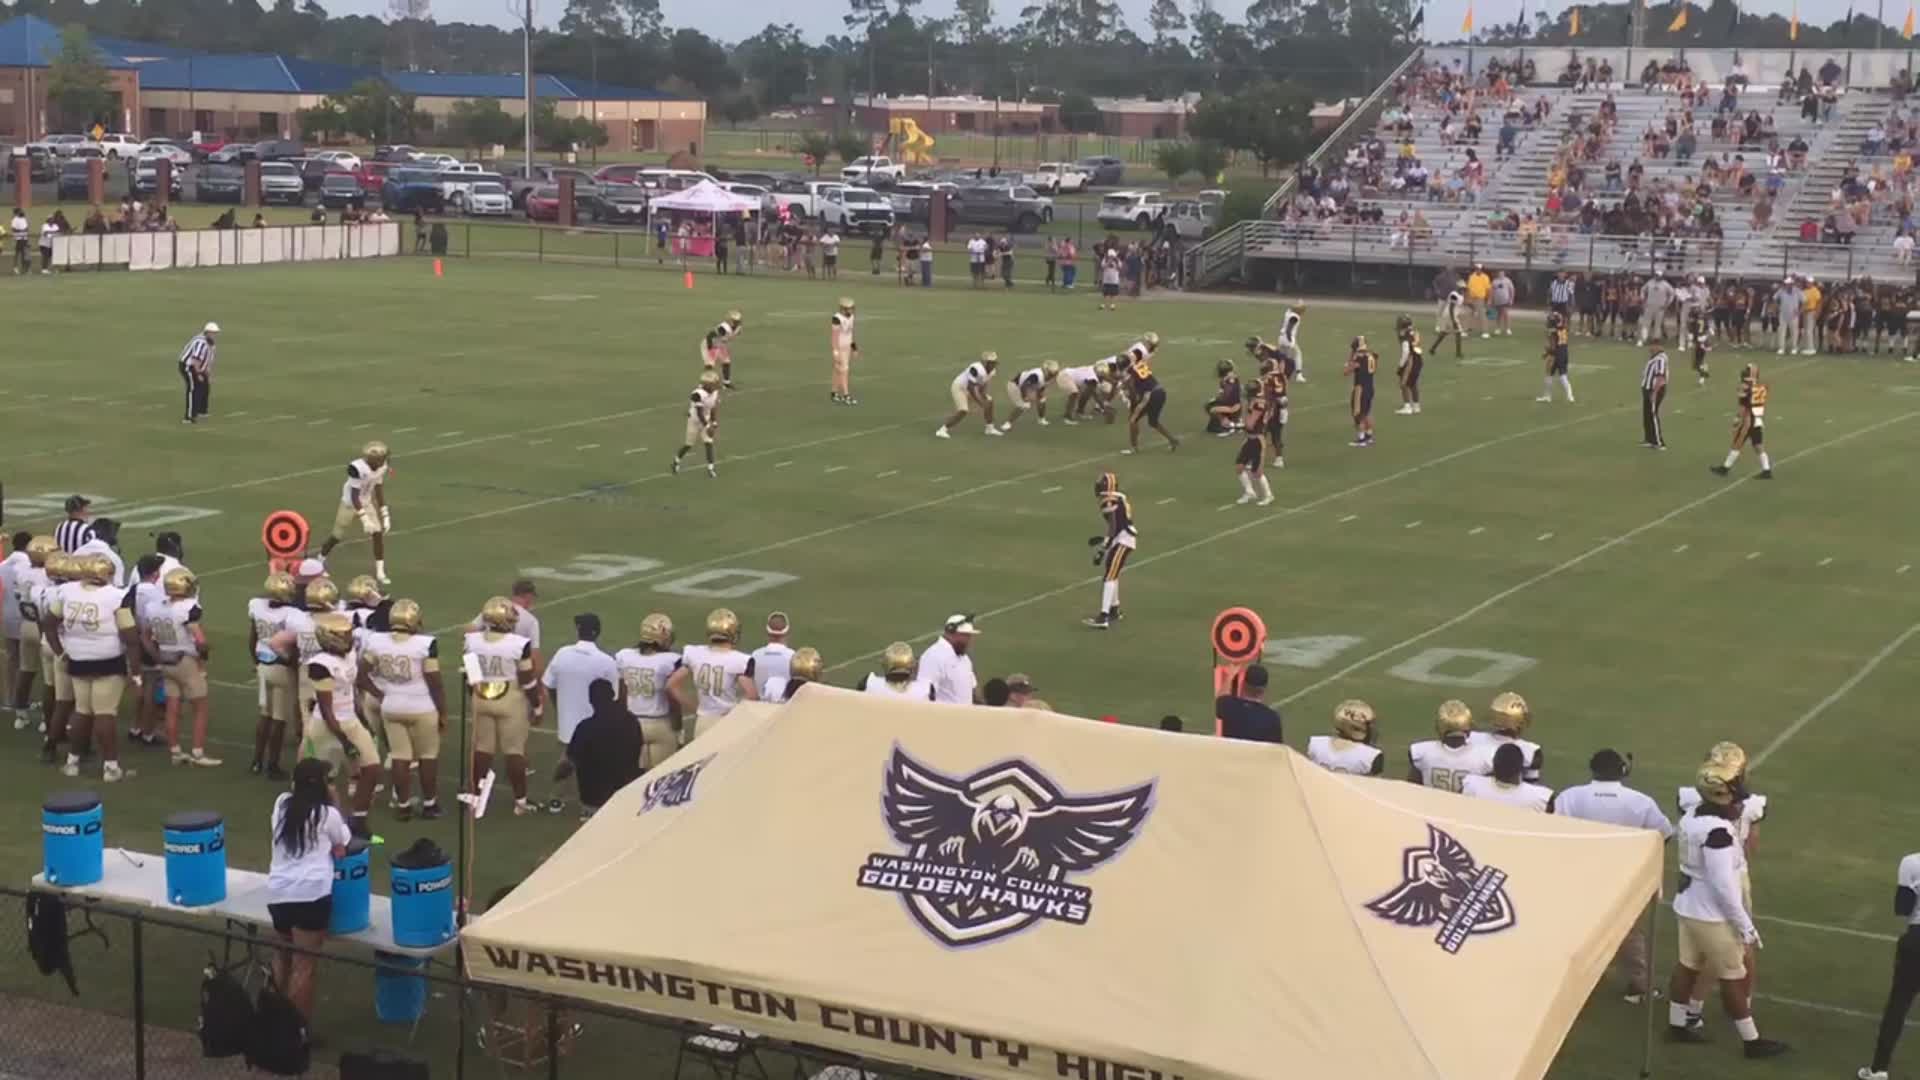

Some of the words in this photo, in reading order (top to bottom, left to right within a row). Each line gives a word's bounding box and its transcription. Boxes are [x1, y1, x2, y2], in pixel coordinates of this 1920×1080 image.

[66, 602, 100, 632] 73
[624, 667, 656, 698] 55
[699, 663, 725, 698] 41
[861, 869, 973, 897] GOLDEN
[980, 885, 1087, 920] HAWKS
[871, 856, 997, 882] WASHINGTON
[1005, 876, 1087, 899] COUNTY
[1445, 900, 1483, 953] GOLDEN
[482, 944, 798, 1022] WASHINGTON
[819, 1003, 1030, 1067] COUNTY
